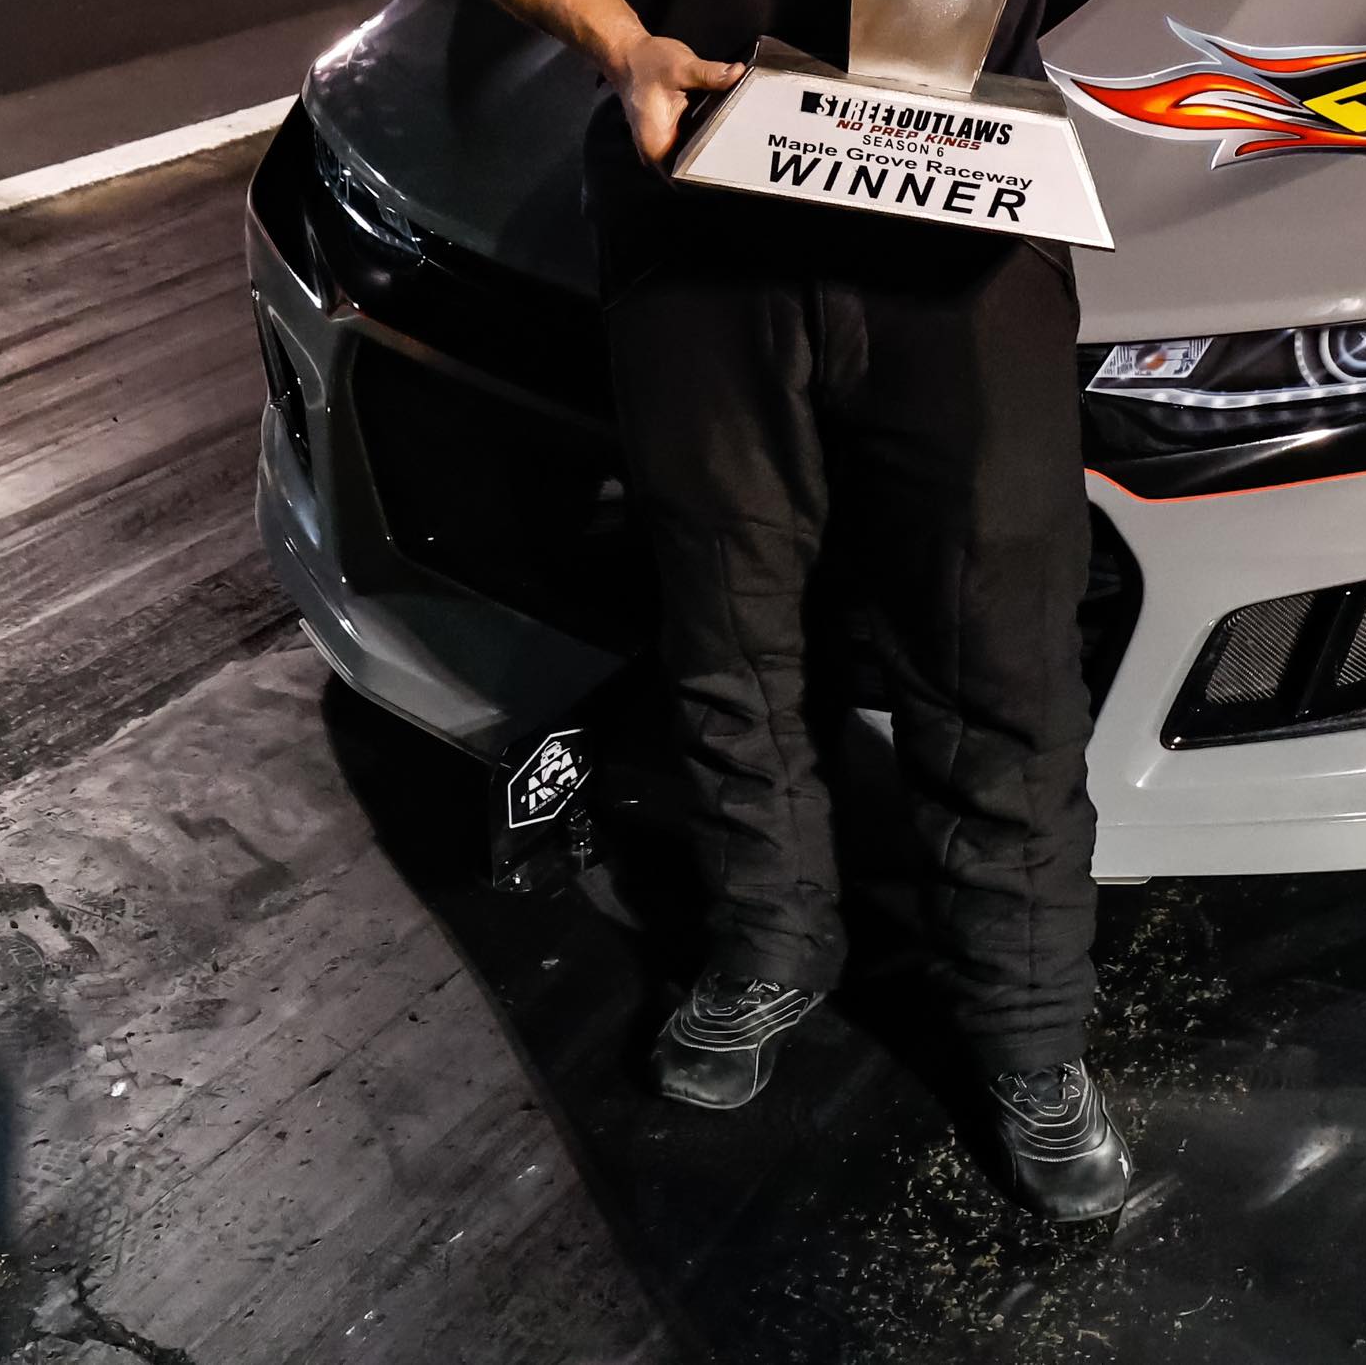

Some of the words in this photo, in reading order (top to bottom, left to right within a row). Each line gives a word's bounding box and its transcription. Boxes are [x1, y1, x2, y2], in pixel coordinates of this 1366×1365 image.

[836, 119, 863, 132] NO
[869, 124, 919, 140] PREP
[924, 133, 983, 151] KINGS
[862, 134, 930, 155] SEASON
[936, 146, 945, 158] 6
[767, 134, 838, 157] Maple
[846, 147, 918, 170] Grove
[926, 160, 1033, 191] Raceway
[769, 151, 1027, 222] WINNER
